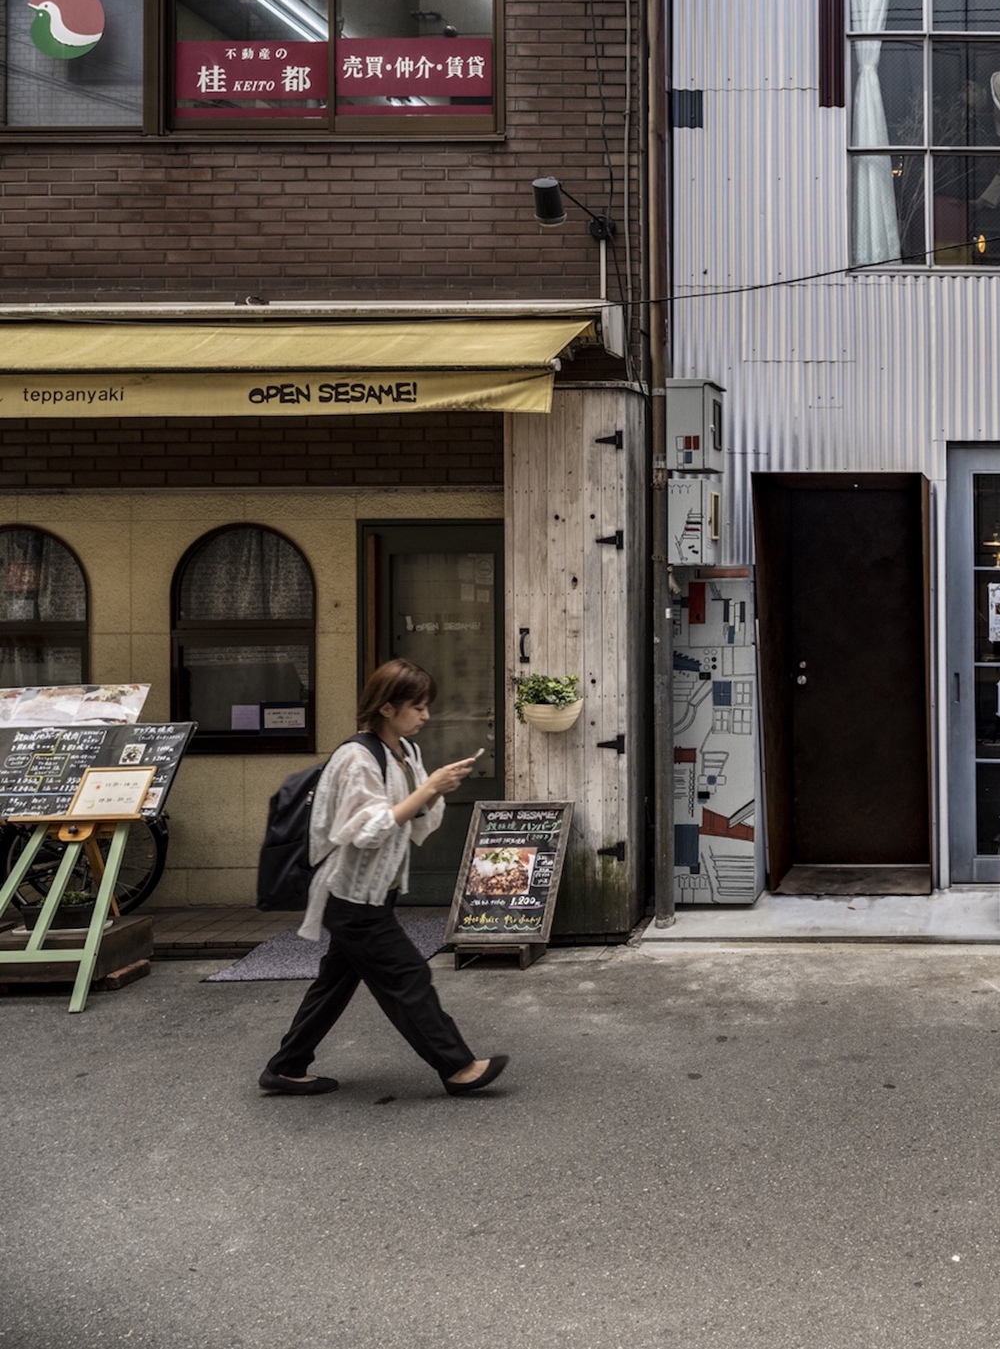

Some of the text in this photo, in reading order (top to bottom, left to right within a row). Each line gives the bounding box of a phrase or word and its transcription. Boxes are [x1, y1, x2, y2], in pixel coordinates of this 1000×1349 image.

[225, 48, 287, 60] 不動産の
[342, 55, 485, 79] 売買・仲介・賃貸
[196, 65, 311, 93] 桂 KEITO 都
[23, 381, 417, 404] teppanyaki OPEN SESAME!
[487, 811, 559, 820] OPEN SESAME!
